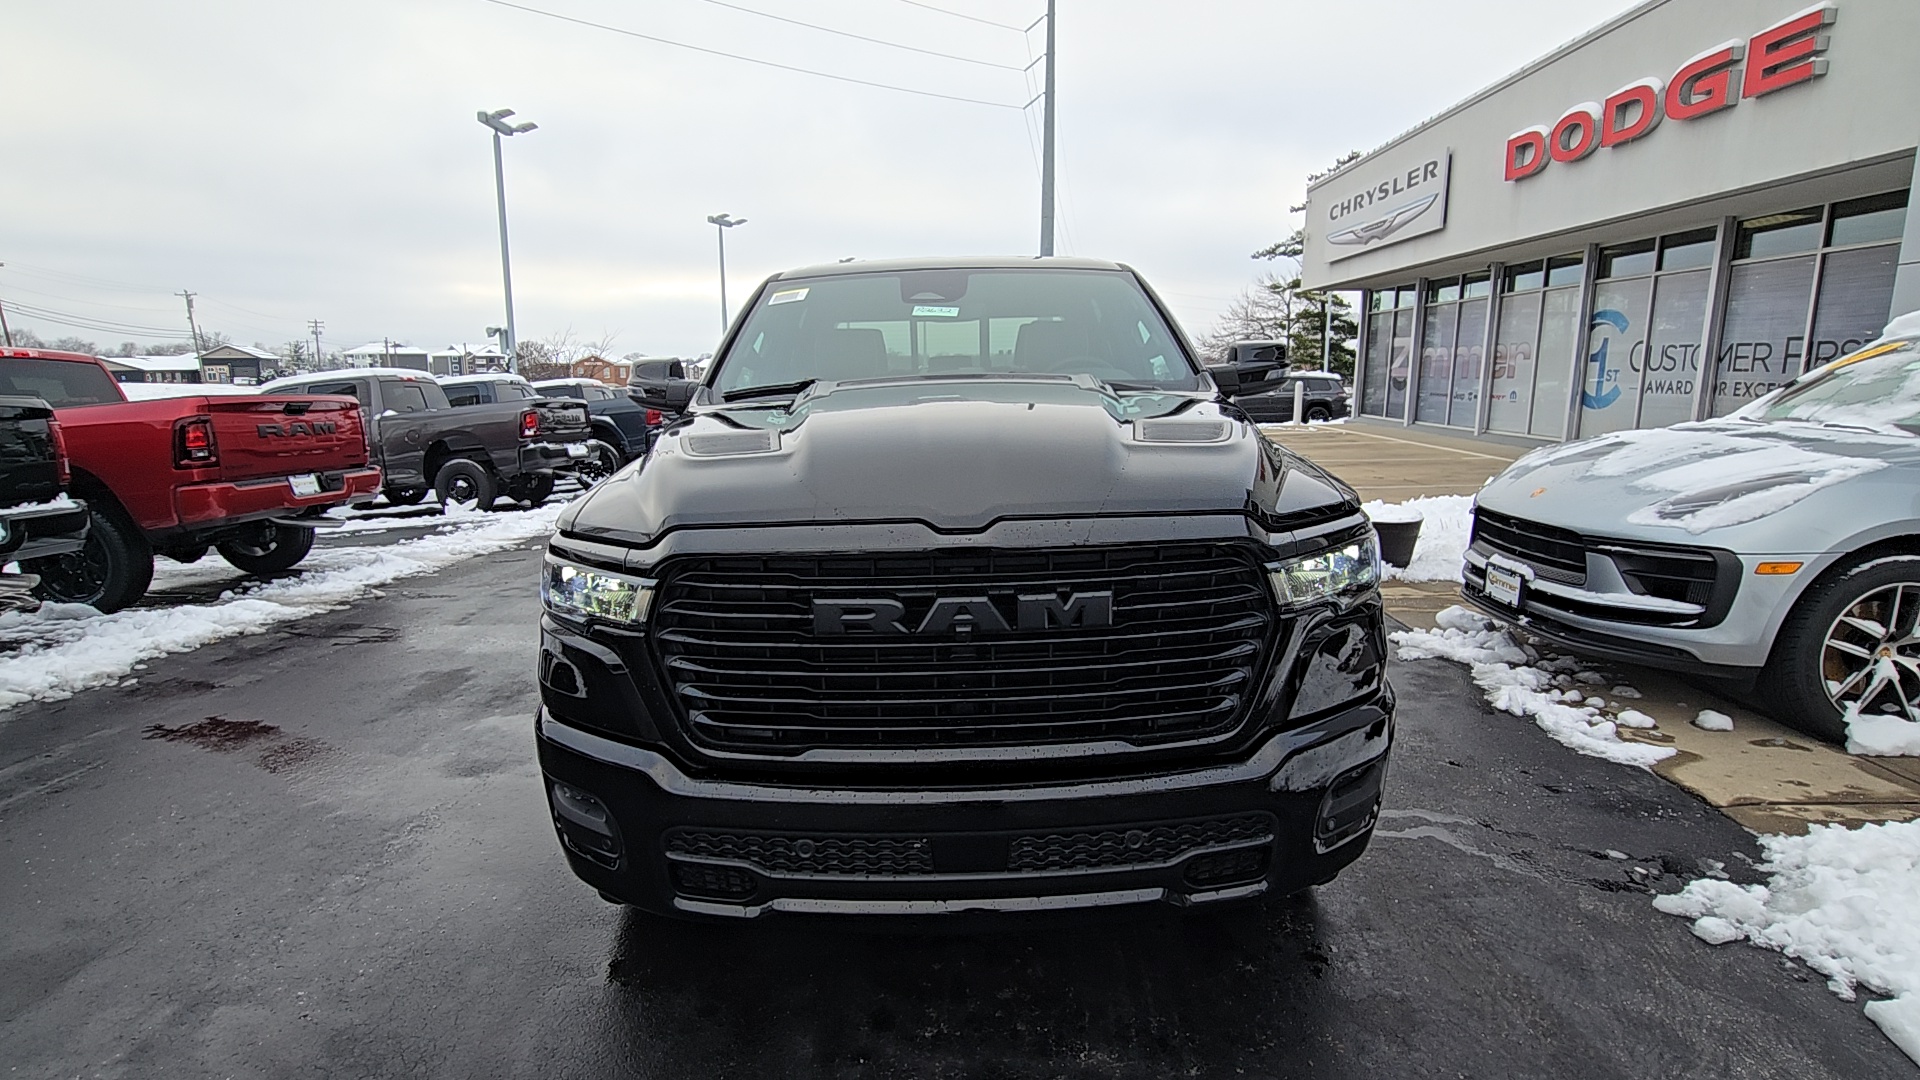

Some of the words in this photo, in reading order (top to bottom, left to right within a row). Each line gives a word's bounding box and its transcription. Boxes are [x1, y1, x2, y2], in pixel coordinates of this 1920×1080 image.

[1504, 6, 1837, 183] DODGE
[1329, 160, 1439, 221] CHRYSLER
[1390, 337, 1532, 379] Zmmer
[1781, 336, 1878, 374] FRS
[1644, 380, 1694, 395] AWARD
[257, 421, 336, 438] RAM
[813, 591, 1113, 635] RAM
